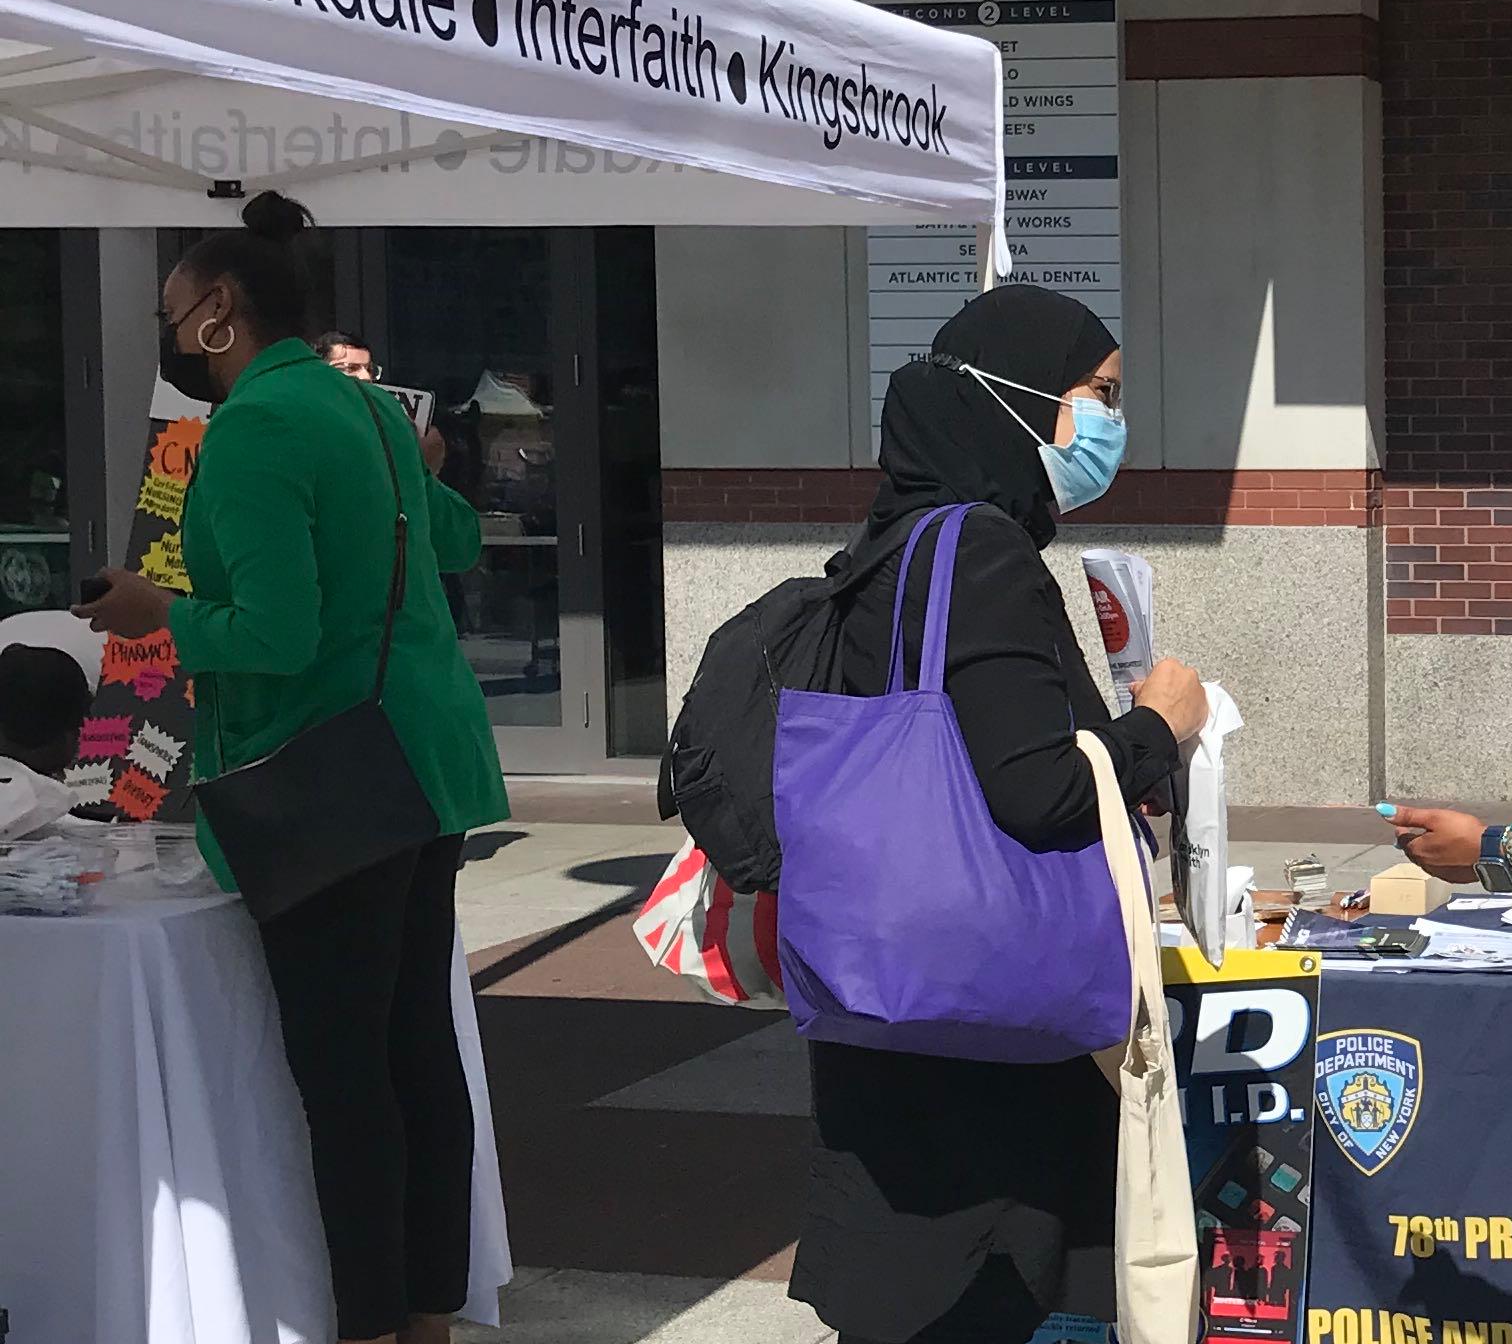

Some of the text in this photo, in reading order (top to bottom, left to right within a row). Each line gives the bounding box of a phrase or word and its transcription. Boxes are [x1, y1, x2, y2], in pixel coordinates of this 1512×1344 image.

[892, 6, 1070, 21] ECOND 2 LEVEL
[759, 35, 951, 156] Kingsbrook
[1023, 95, 1073, 108] WINGS
[1004, 123, 1035, 135] EE'S
[1013, 162, 1073, 173] LEVEL
[1006, 189, 1048, 201] BWAY
[1017, 216, 1072, 228] WORKS
[888, 271, 960, 284] ATLANTIC
[1043, 271, 1100, 283] DENTAL
[1336, 1036, 1394, 1054] POLICE
[1315, 1052, 1416, 1080] DEPARTMENT
[1212, 1082, 1305, 1125] I.D.
[1318, 1087, 1416, 1160] CITY OF NEW YORK
[1388, 1215, 1459, 1258] 78th
